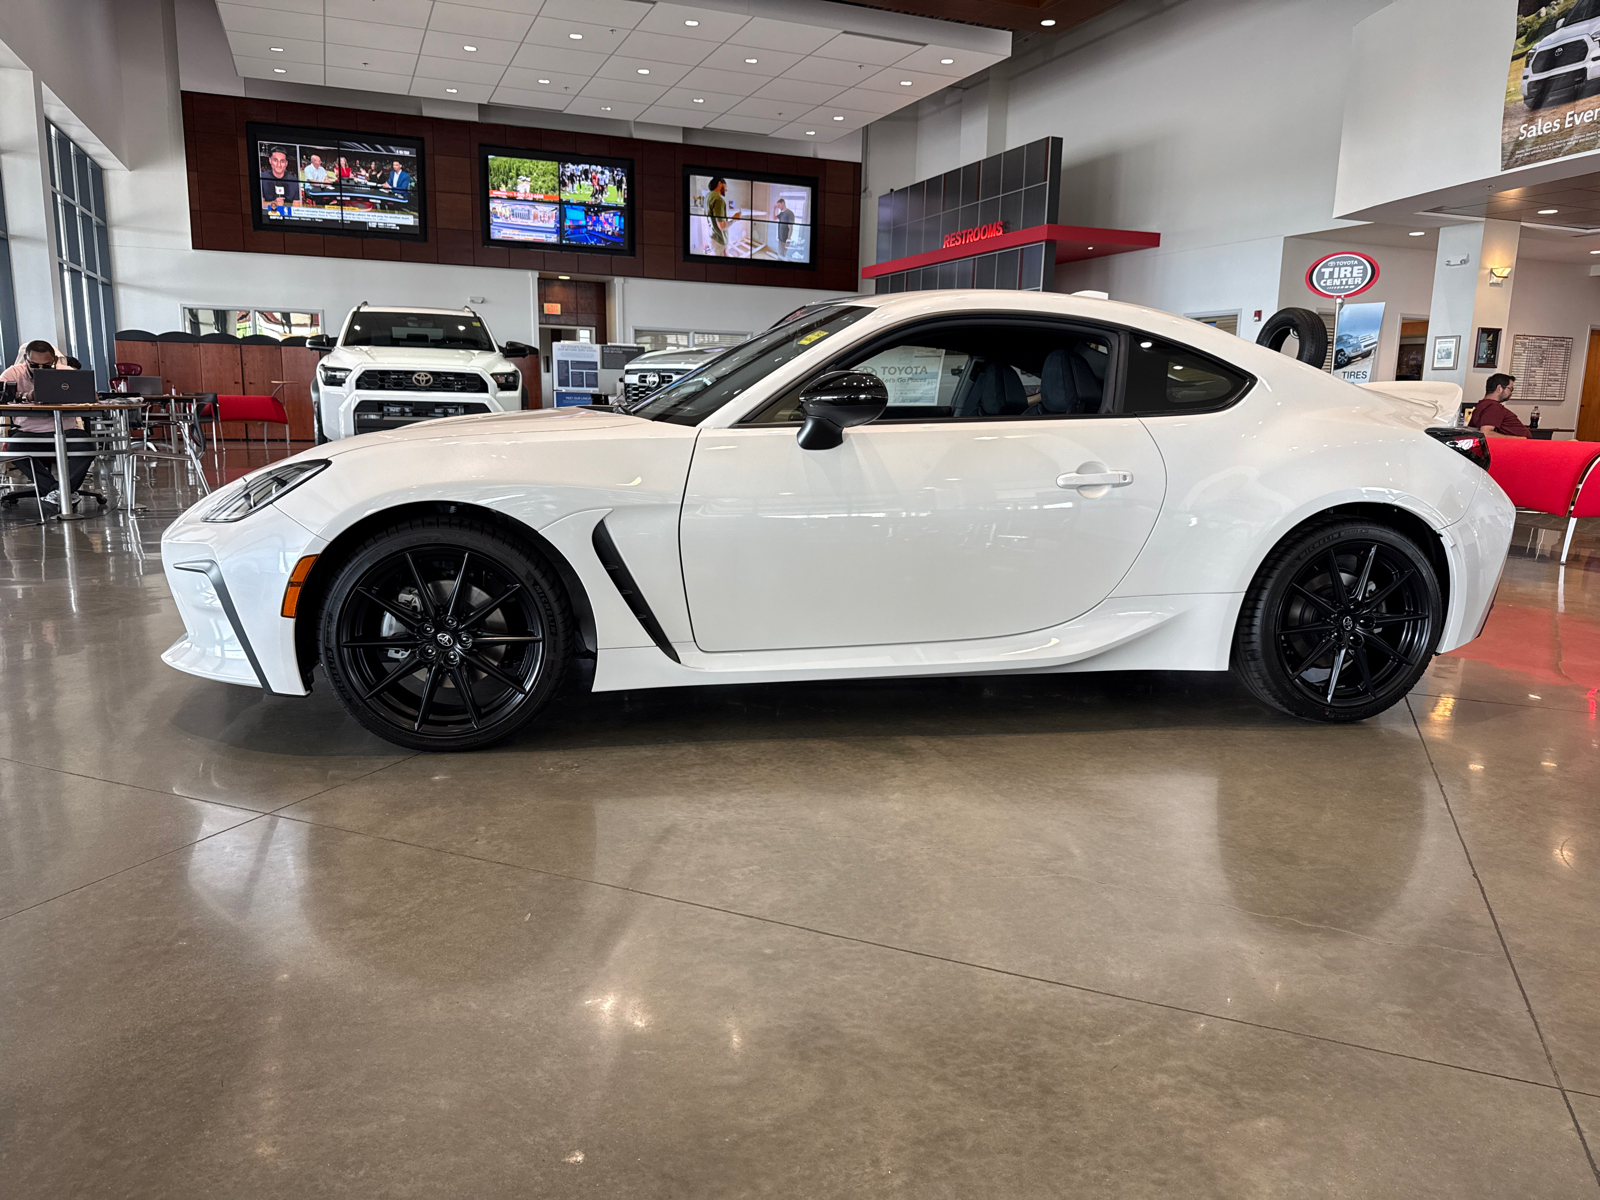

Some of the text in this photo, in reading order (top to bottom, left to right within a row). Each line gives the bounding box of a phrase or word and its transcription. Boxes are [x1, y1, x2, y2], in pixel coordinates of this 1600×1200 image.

[1519, 119, 1561, 140] Sales
[943, 220, 1003, 248] RESTROOMS
[1321, 266, 1364, 278] TIRE
[1320, 278, 1362, 286] CENTER
[881, 365, 928, 376] TOYOTA
[1342, 371, 1367, 379] TIRES
[533, 584, 558, 637] MICHELIN
